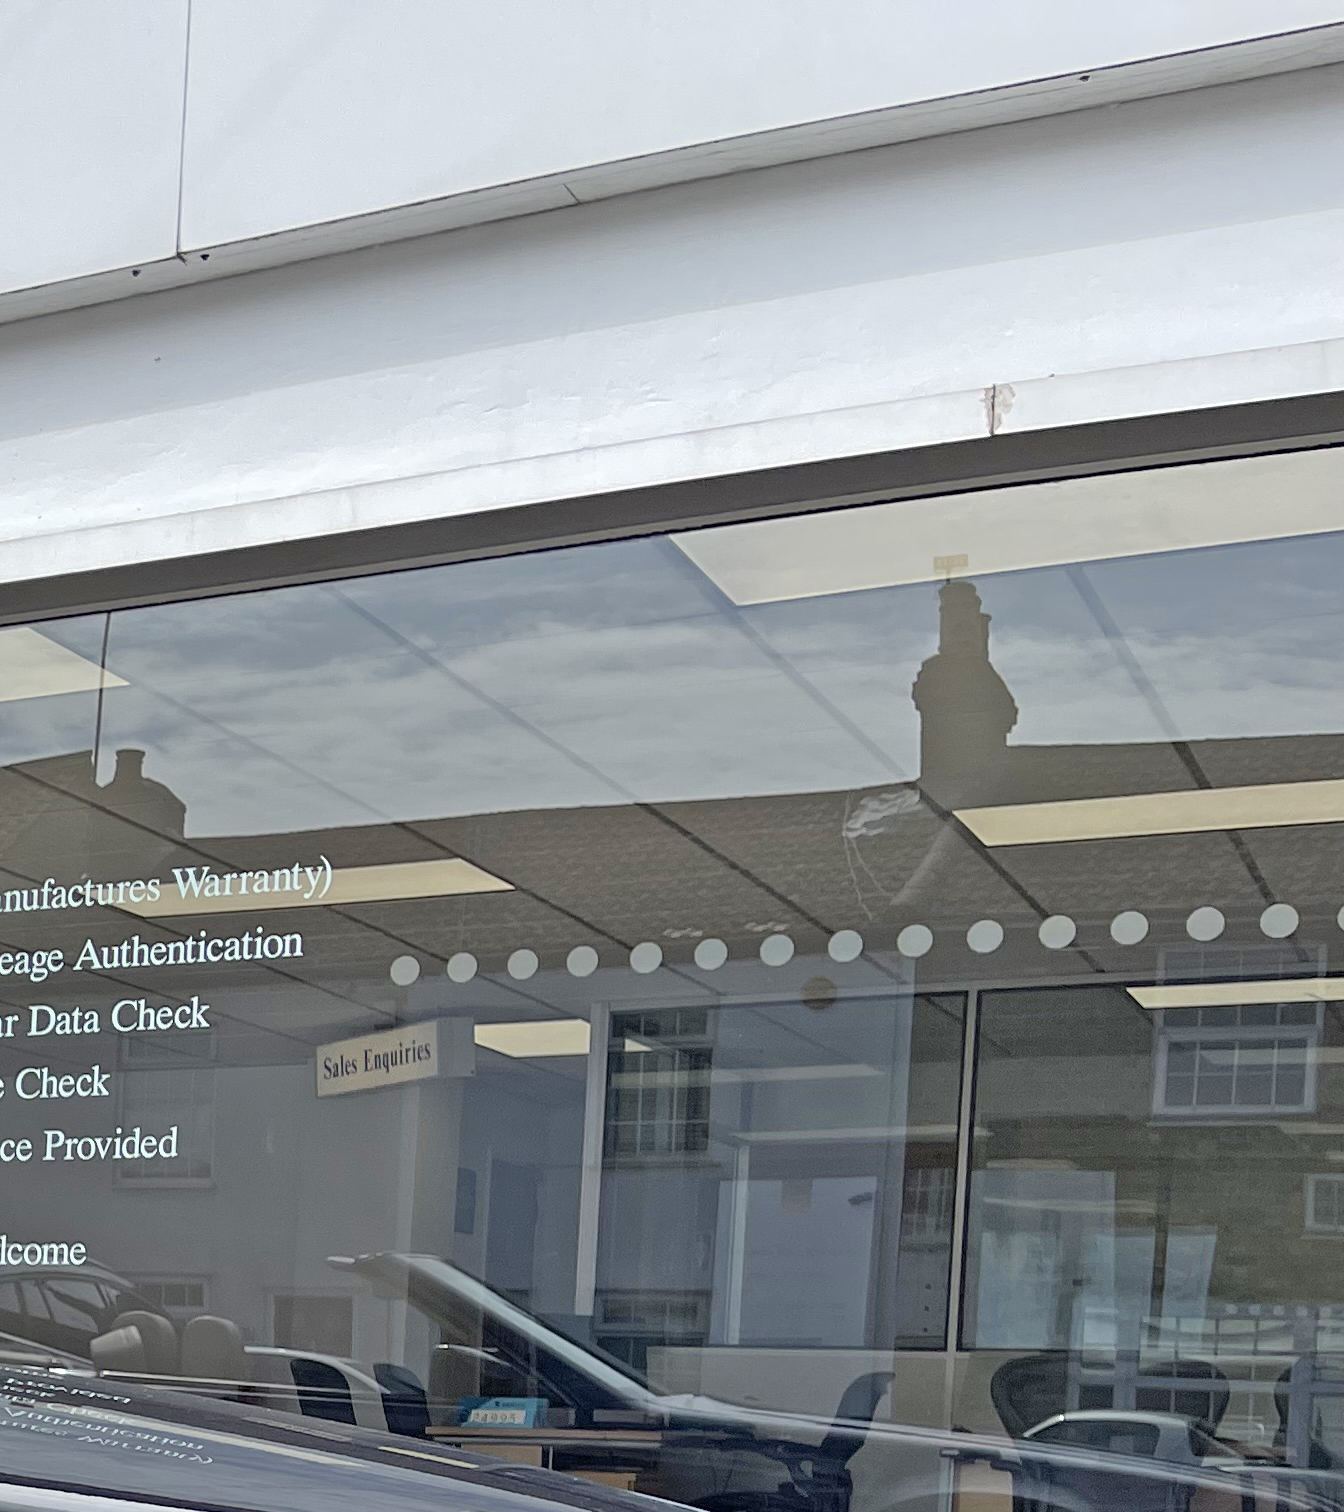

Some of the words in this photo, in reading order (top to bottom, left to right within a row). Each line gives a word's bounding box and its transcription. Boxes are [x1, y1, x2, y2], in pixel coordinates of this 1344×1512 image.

[172, 855, 331, 899] Warranty)
[73, 926, 304, 973] Authentication
[27, 1005, 100, 1036] Data
[112, 996, 210, 1031] Check
[323, 1055, 358, 1080] Sales
[364, 1040, 430, 1073] Enquiries
[16, 1065, 110, 1099] Check
[43, 1126, 178, 1160] Provided
